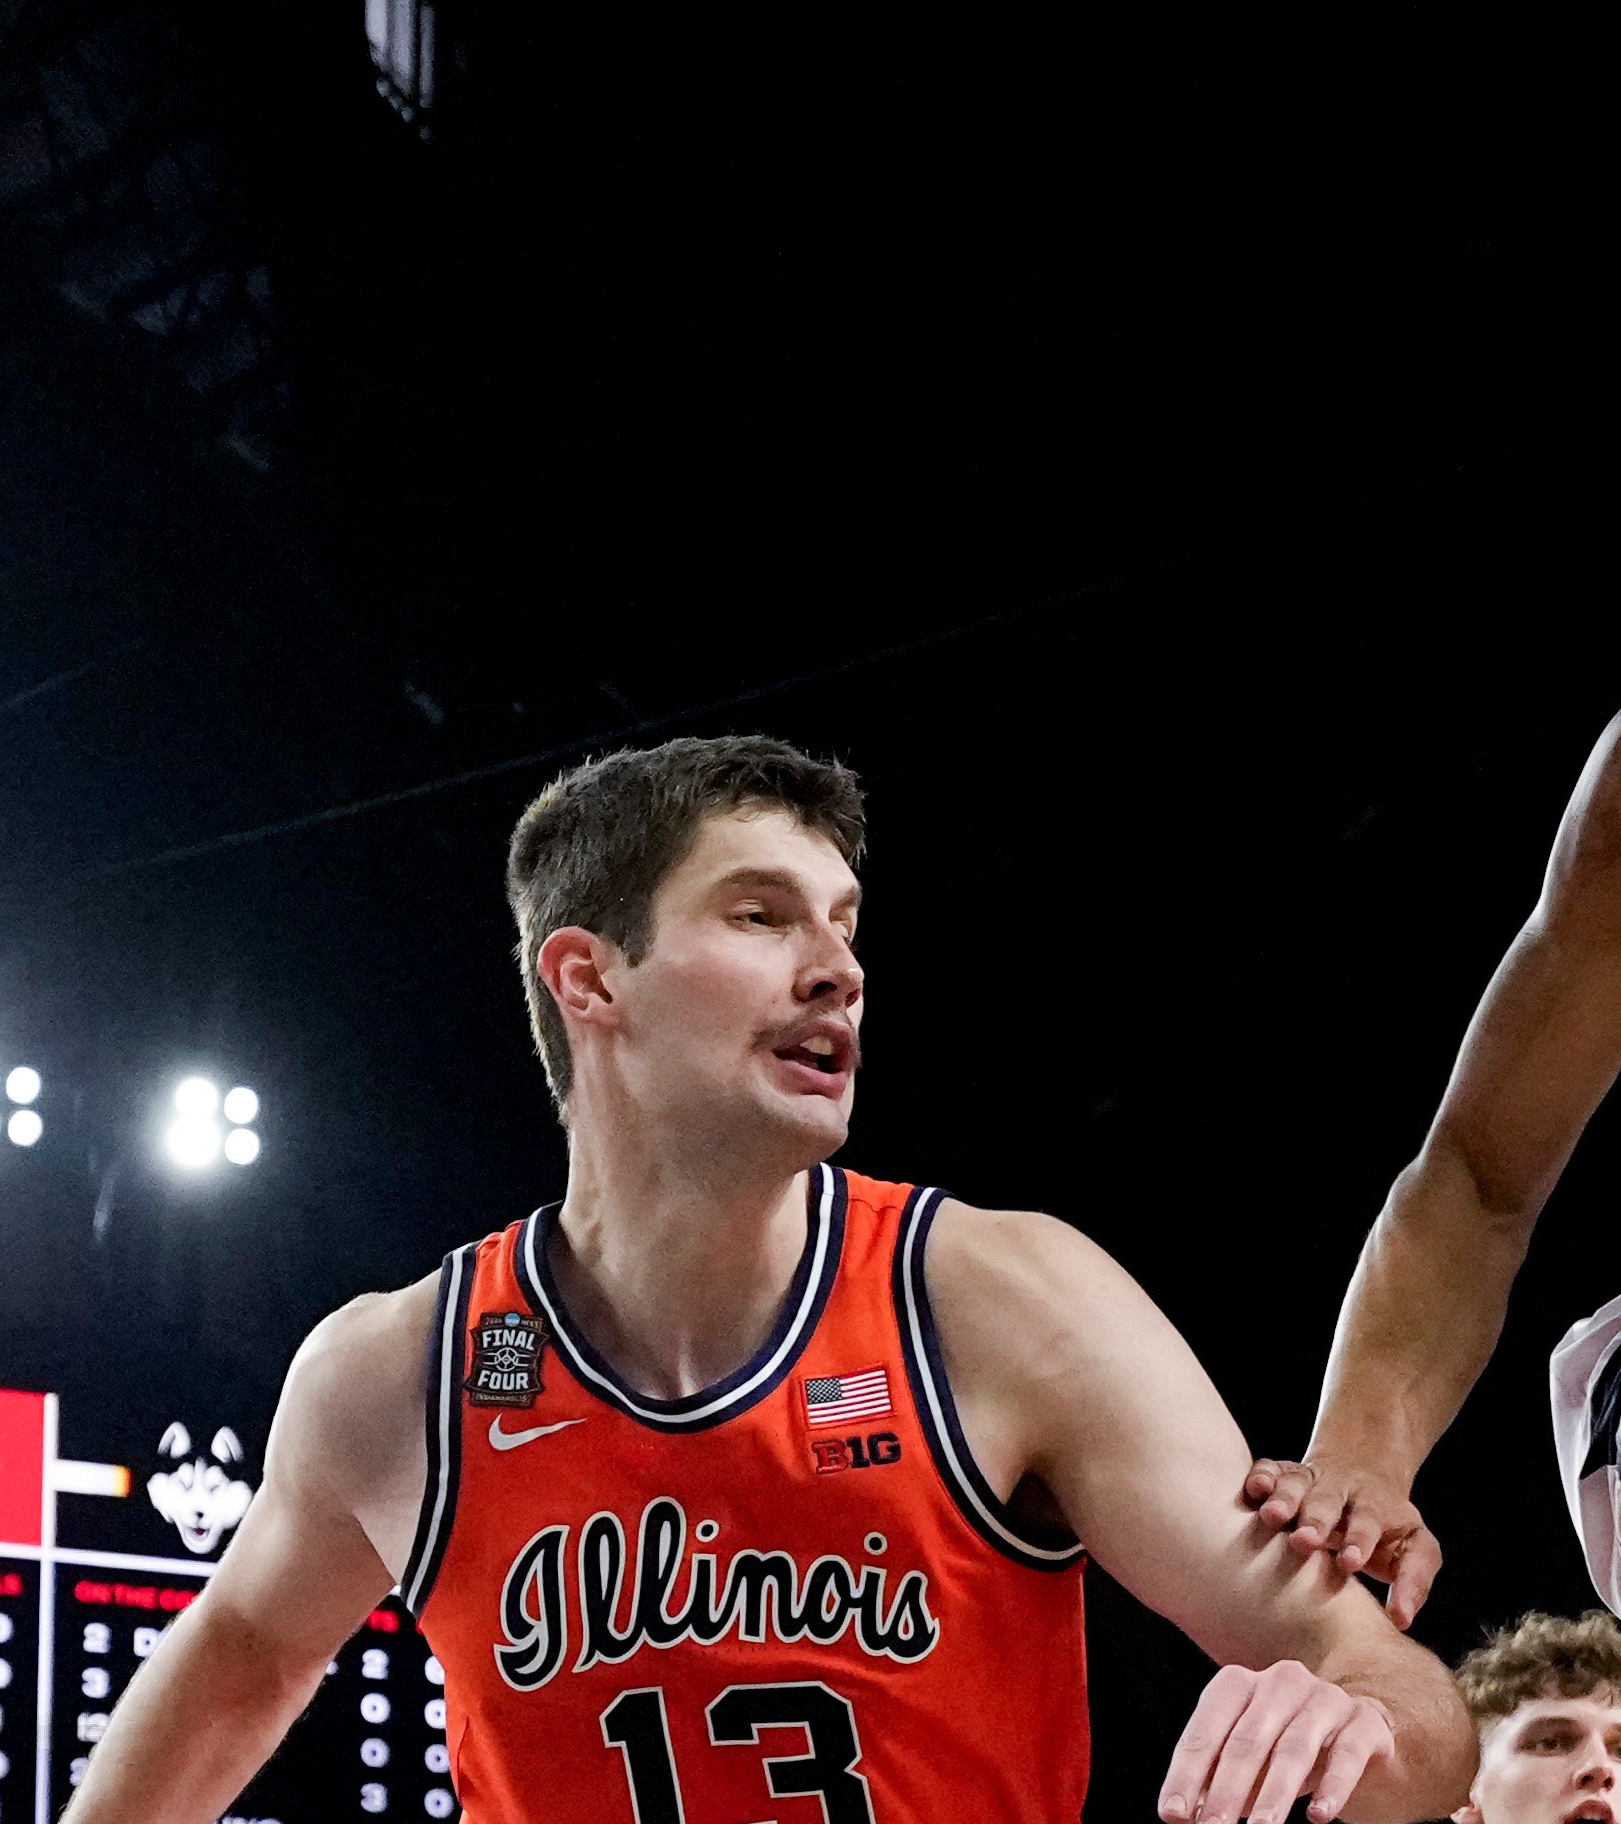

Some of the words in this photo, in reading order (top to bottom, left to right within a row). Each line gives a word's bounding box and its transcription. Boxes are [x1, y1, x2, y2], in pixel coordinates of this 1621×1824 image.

[482, 1329, 535, 1351] FINAL
[477, 1369, 529, 1390] FOUR
[494, 1495, 941, 1693] Illinois
[83, 1622, 112, 1654] 2
[361, 1648, 390, 1680] 2
[82, 1667, 110, 1699] 3
[359, 1692, 391, 1724] 0
[359, 1737, 391, 1769] 0
[424, 1744, 451, 1774] 0
[359, 1782, 389, 1814] 3
[424, 1788, 455, 1819] 0
